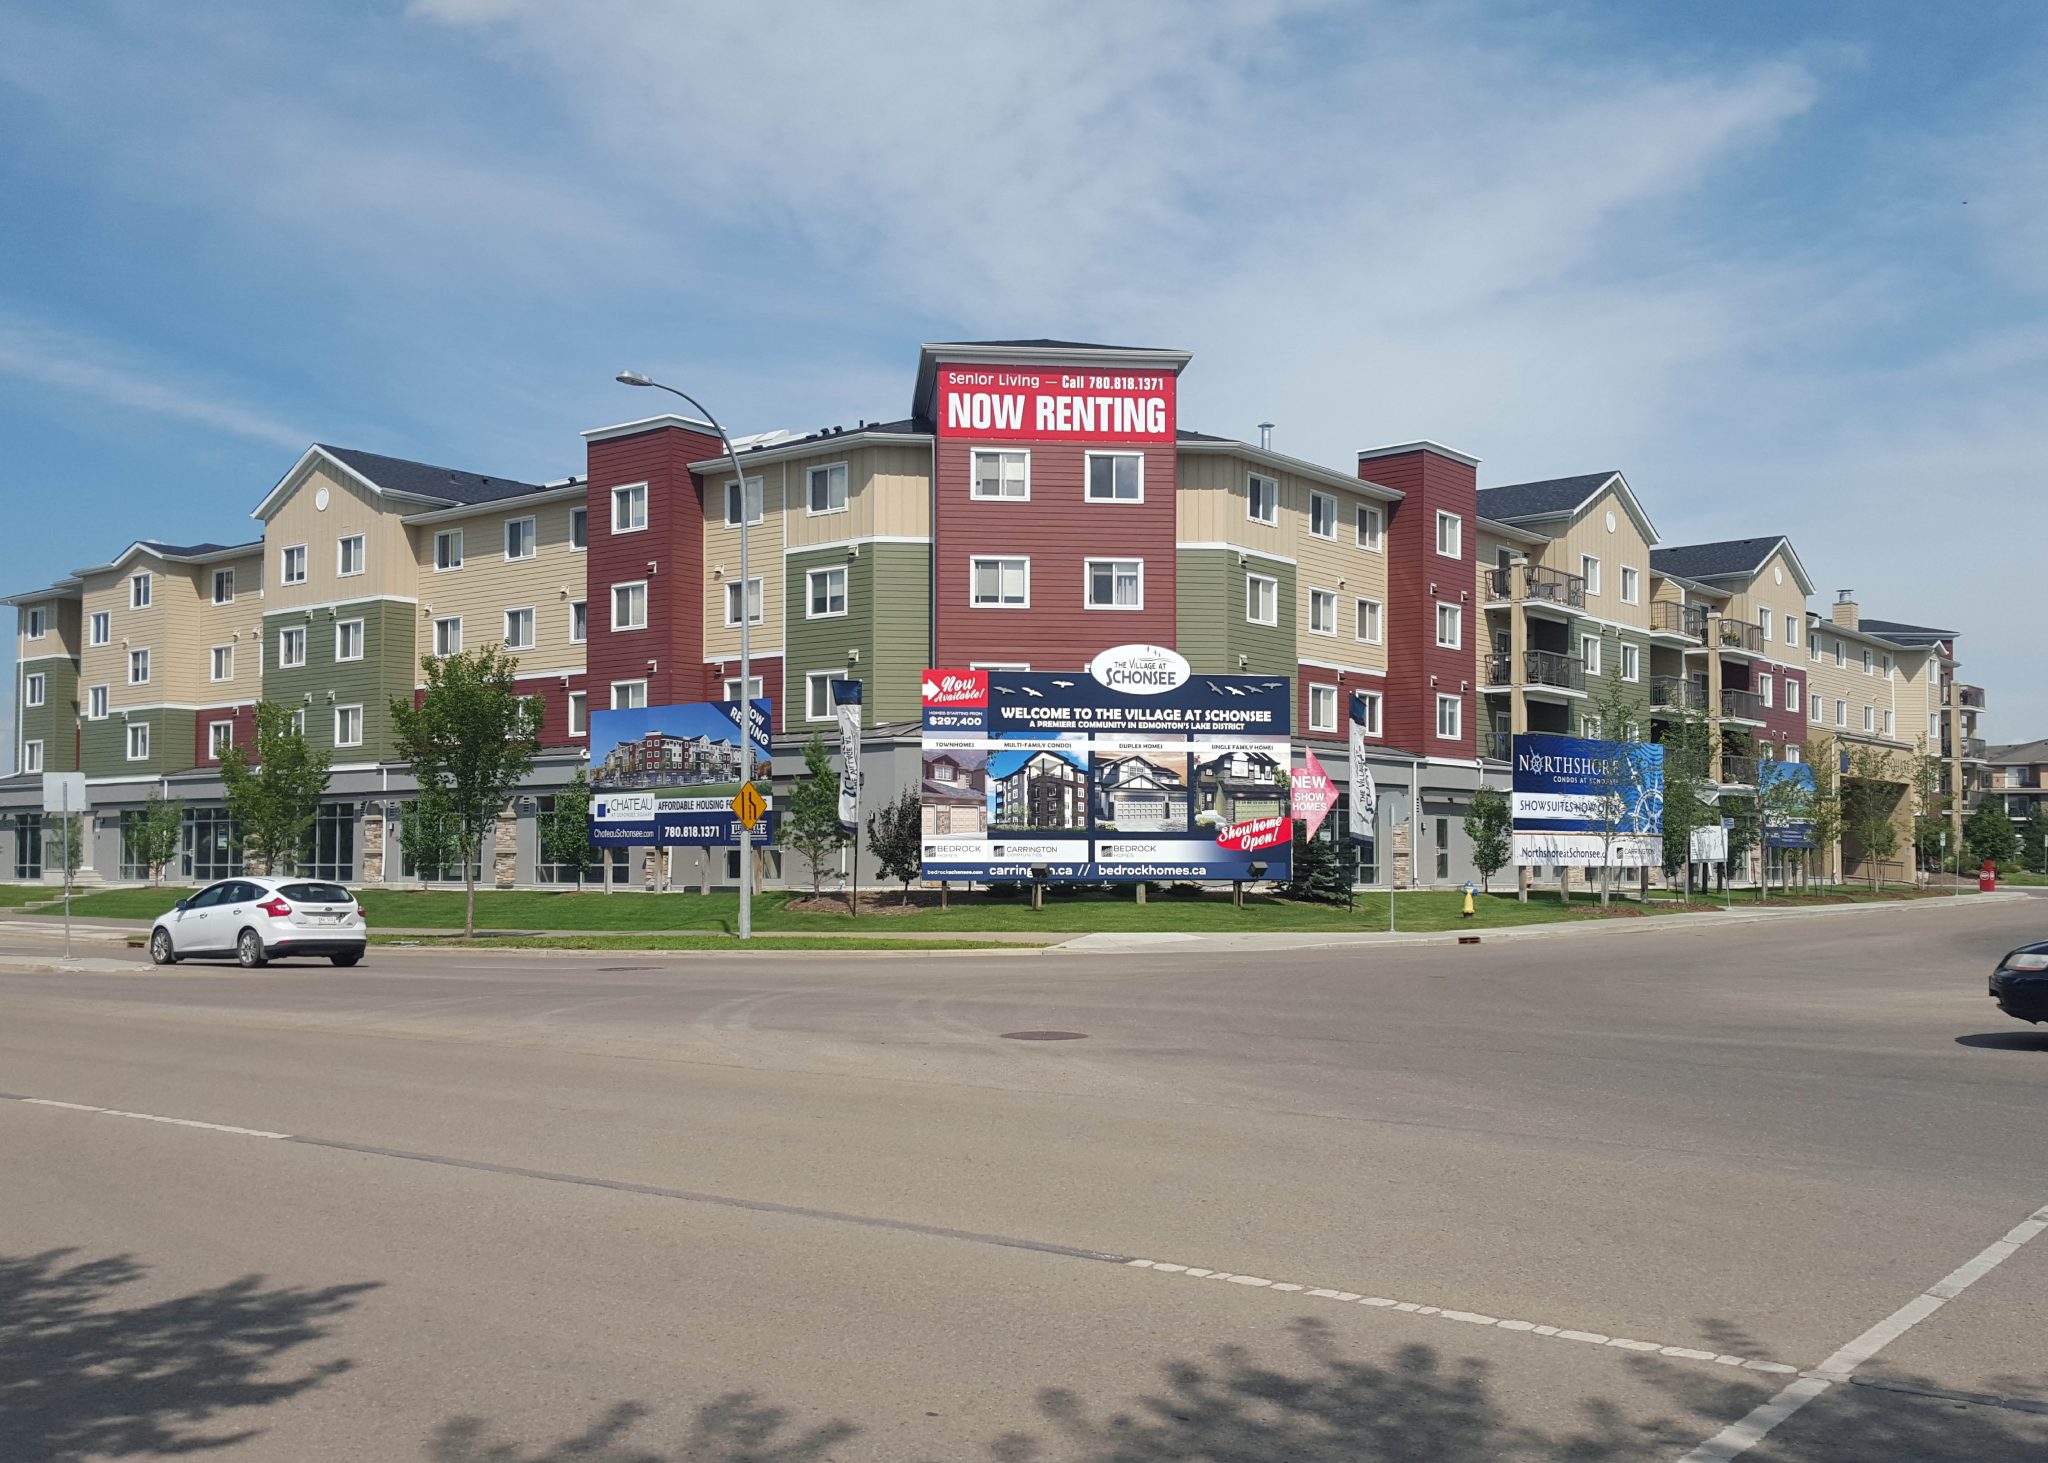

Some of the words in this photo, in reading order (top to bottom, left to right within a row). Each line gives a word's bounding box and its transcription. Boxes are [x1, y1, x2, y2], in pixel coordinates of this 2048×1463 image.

[949, 372, 994, 386] Senior
[998, 374, 1040, 389] Living
[1062, 375, 1084, 389] Call
[1089, 375, 1164, 391] 780.818.1371
[948, 392, 1026, 430] NOW
[1036, 395, 1166, 434] RENTING
[1114, 661, 1127, 669] THE
[1158, 662, 1167, 670] AT
[1106, 667, 1176, 687] SCHONSEE
[941, 675, 976, 693] Now
[933, 687, 986, 704] Available!
[929, 716, 982, 727] $297,400
[1001, 707, 1070, 720] WELCOME
[1073, 708, 1093, 720] TO
[1095, 708, 1122, 721] THE
[1124, 708, 1183, 721] VILLAGE
[1186, 709, 1202, 722] AT
[1204, 709, 1272, 723] SCHONSEE
[1029, 720, 1036, 728] A
[1037, 720, 1077, 729] PREMIERE
[1078, 721, 1127, 730] COMMUNITY
[1128, 721, 1137, 729] IN
[1138, 721, 1190, 731] EDMONTON'S
[1191, 722, 1212, 731] LAKE
[1212, 722, 1246, 731] DISTRICT
[1292, 776, 1327, 789] NEW
[1553, 776, 1578, 784] CONDOS
[1294, 792, 1325, 801] SHOW
[611, 798, 653, 811] CHATEAU
[657, 800, 694, 811] AFFORDABLE
[696, 799, 724, 811] HOUSING
[1292, 802, 1327, 812] HOMES
[593, 828, 655, 838] ChateauSchonsee.com
[664, 825, 720, 838] 780.818.1371
[1219, 816, 1283, 843] Showhome
[1241, 828, 1279, 852] Open!
[937, 845, 982, 853] BEDROCK
[989, 864, 1073, 878] carringn.ca
[1098, 864, 1207, 877] bedrockhomes.ca
